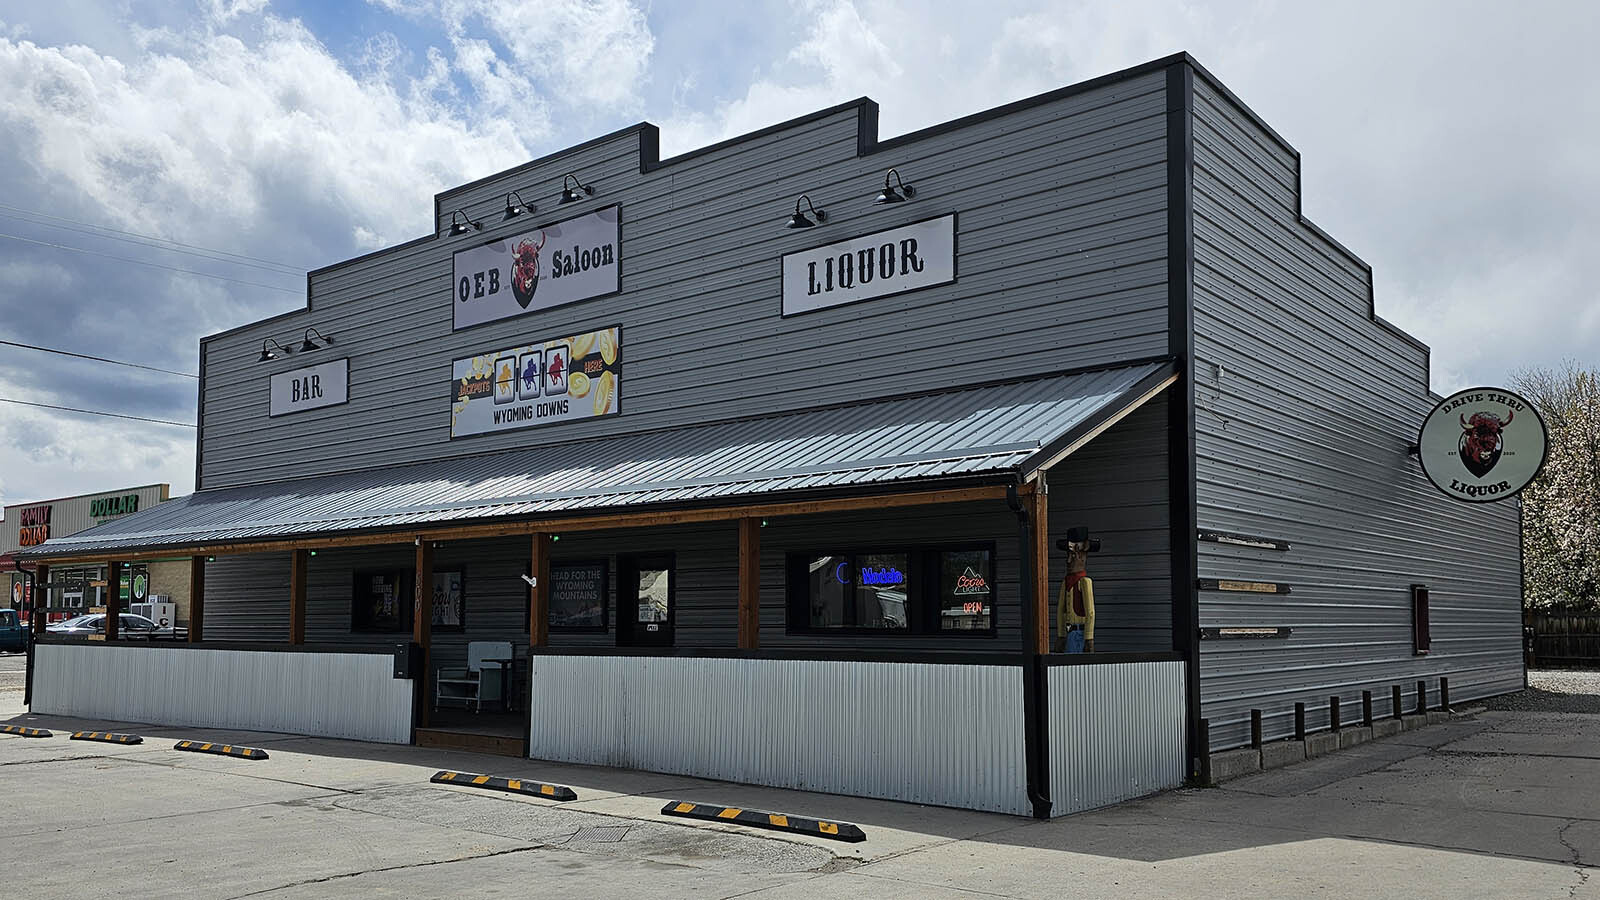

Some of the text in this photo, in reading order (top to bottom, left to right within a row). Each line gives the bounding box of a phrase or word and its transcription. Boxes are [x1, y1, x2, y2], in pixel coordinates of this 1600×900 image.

[552, 242, 614, 279] Saloon
[807, 238, 924, 296] LIQUOR
[584, 359, 603, 373] HERE
[291, 374, 323, 403] BAR
[458, 382, 490, 396] JACKPOTS
[493, 400, 569, 425] WYOMING DOWNS
[1441, 393, 1525, 414] DRIVE THRU
[1449, 479, 1512, 497] LIQUOR
[90, 495, 138, 517] DOLLAR
[21, 505, 51, 526] FAMILY
[20, 524, 49, 546] DOLLAR
[551, 568, 600, 580] HEAD FOR THE
[862, 567, 903, 584] Modelo
[957, 575, 984, 588] Coors
[556, 581, 594, 590] WYOMING
[553, 591, 598, 600] MOUNTAINS
[963, 602, 982, 613] OPEN
